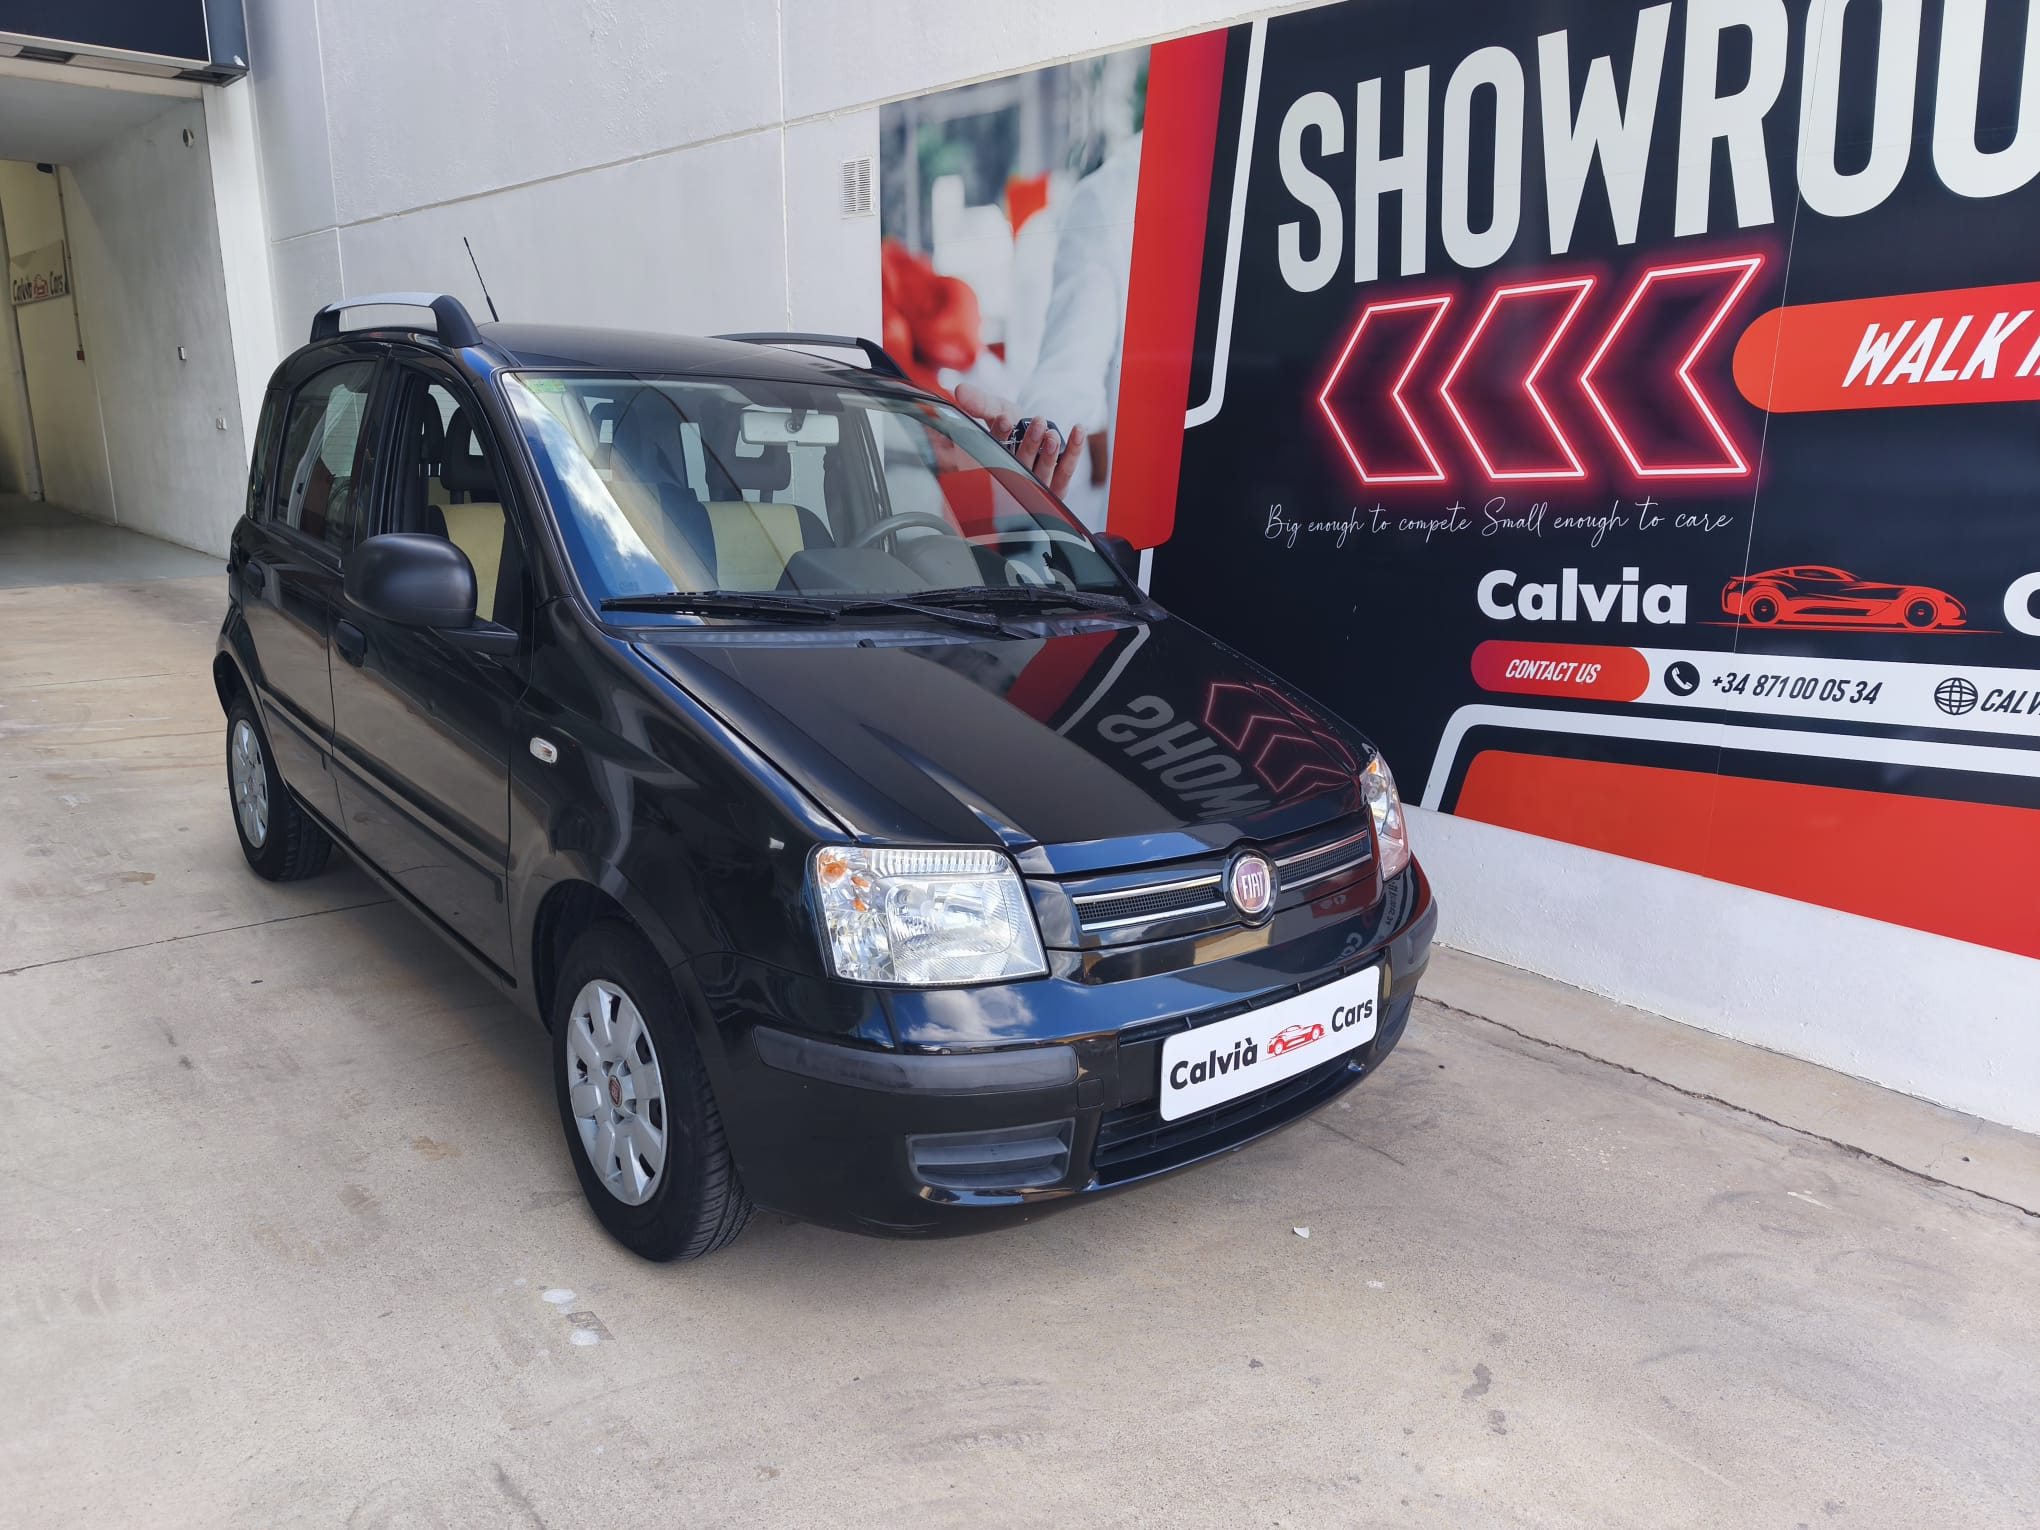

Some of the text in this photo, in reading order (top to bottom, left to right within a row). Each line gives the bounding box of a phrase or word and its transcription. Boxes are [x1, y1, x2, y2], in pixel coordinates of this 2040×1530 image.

[1841, 310, 2035, 387] WALK
[1265, 496, 1734, 549] Big enough to compete Small enough to care
[1477, 566, 1688, 625] Calvia
[1505, 659, 1602, 684] CONTACT US
[1712, 672, 1751, 695] +34
[1819, 678, 1851, 702] 05
[1849, 680, 1883, 704] 34
[1241, 871, 1264, 900] FIAT
[1169, 999, 1373, 1090] Calvià Cars
